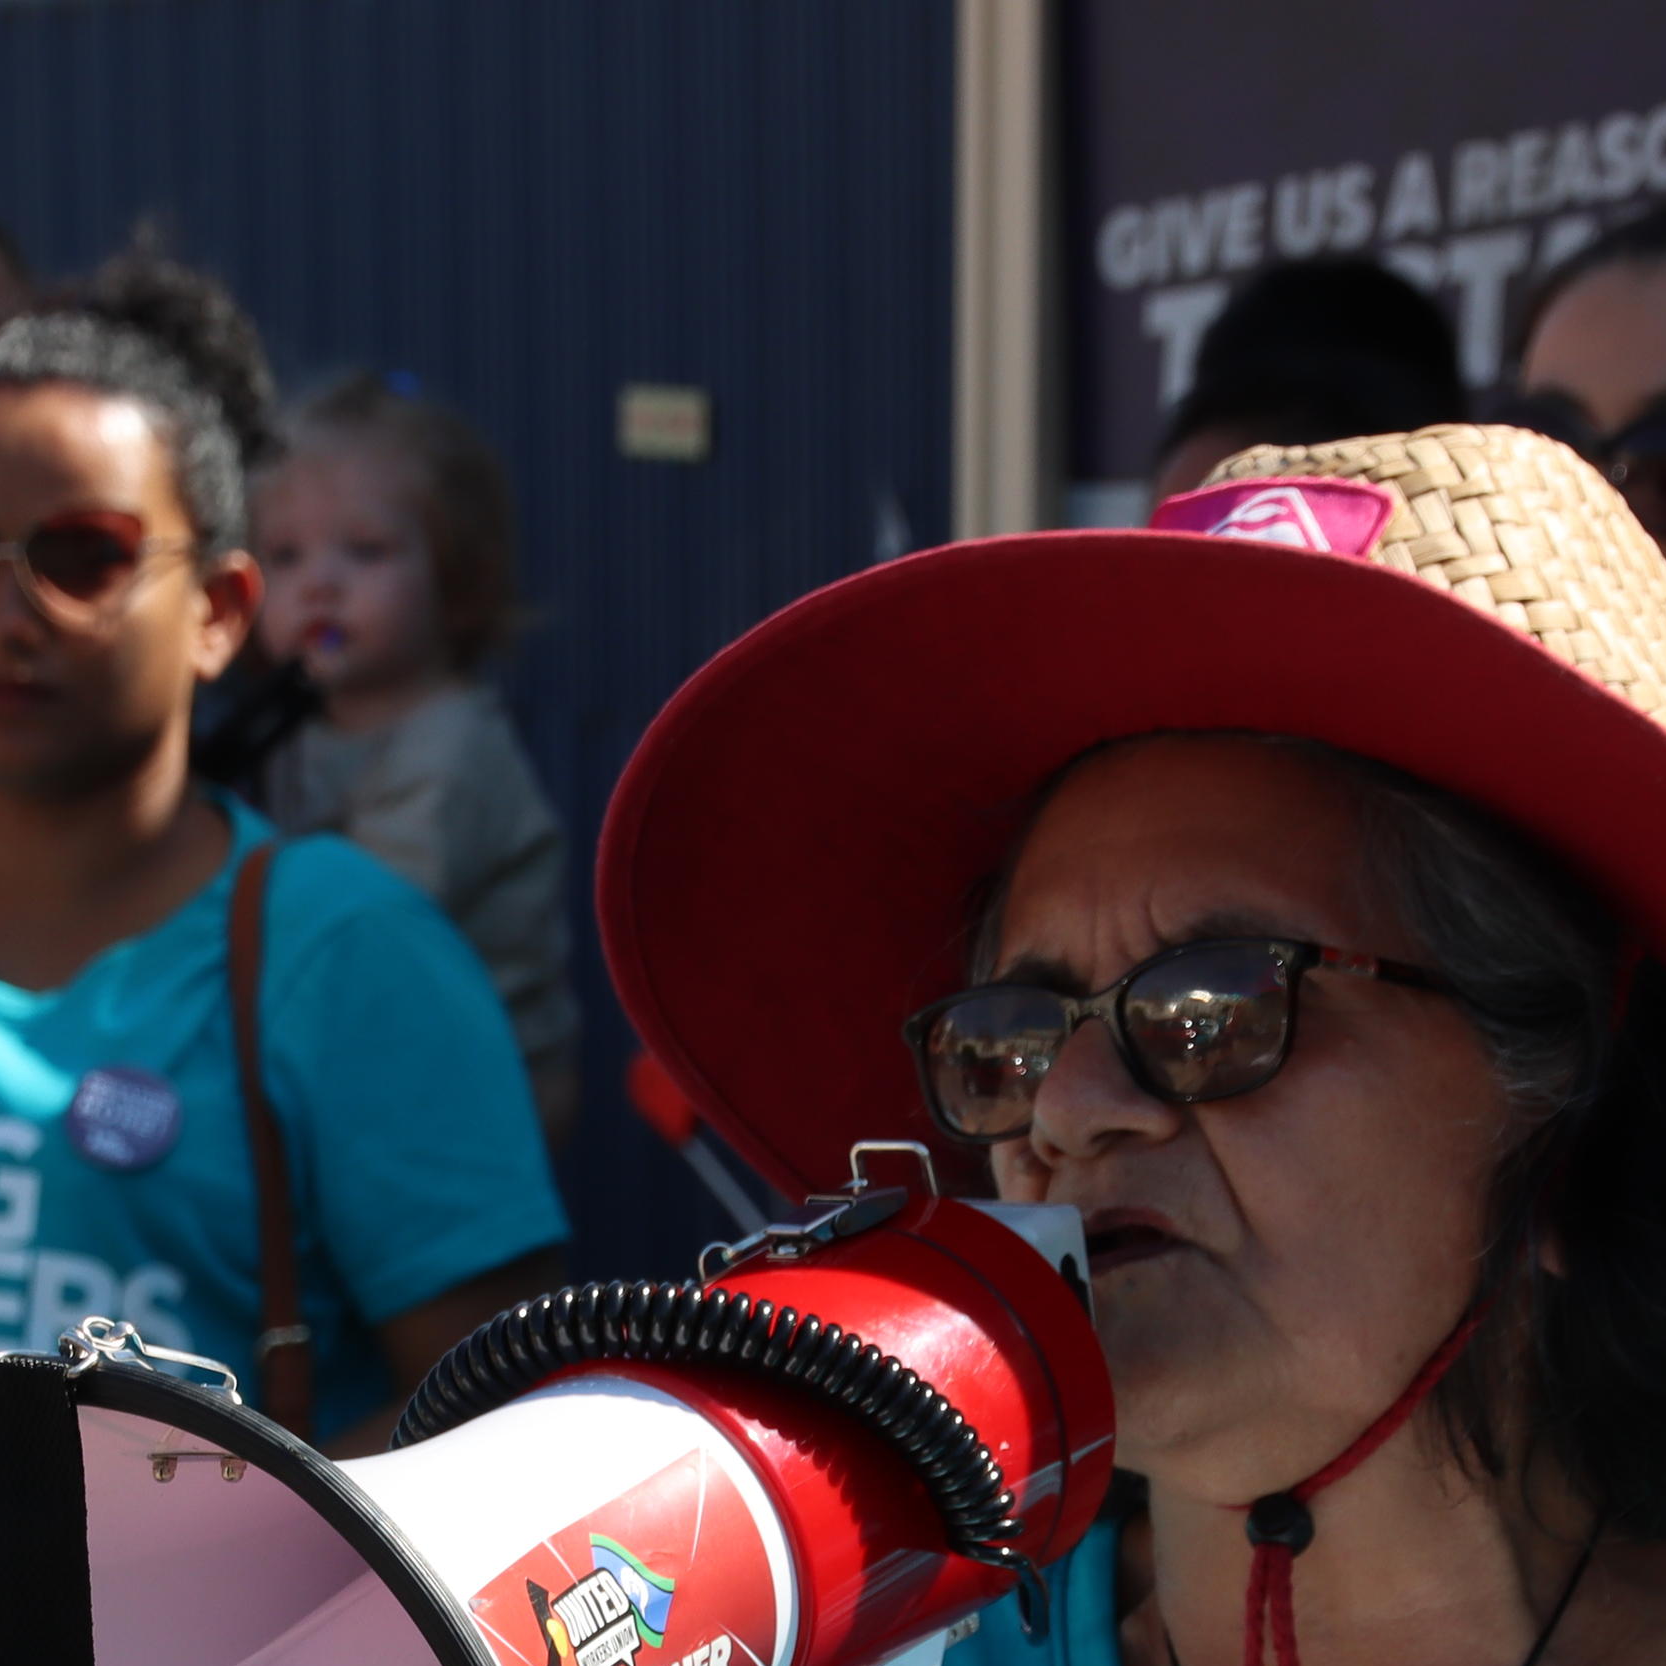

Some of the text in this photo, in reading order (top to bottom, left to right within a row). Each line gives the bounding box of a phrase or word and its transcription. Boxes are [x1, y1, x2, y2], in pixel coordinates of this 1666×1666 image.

[1097, 181, 1264, 290] GIVE
[1274, 162, 1375, 258] US
[1383, 150, 1439, 238] A
[553, 1570, 629, 1648] UNITED
[612, 1626, 635, 1656] UNION
